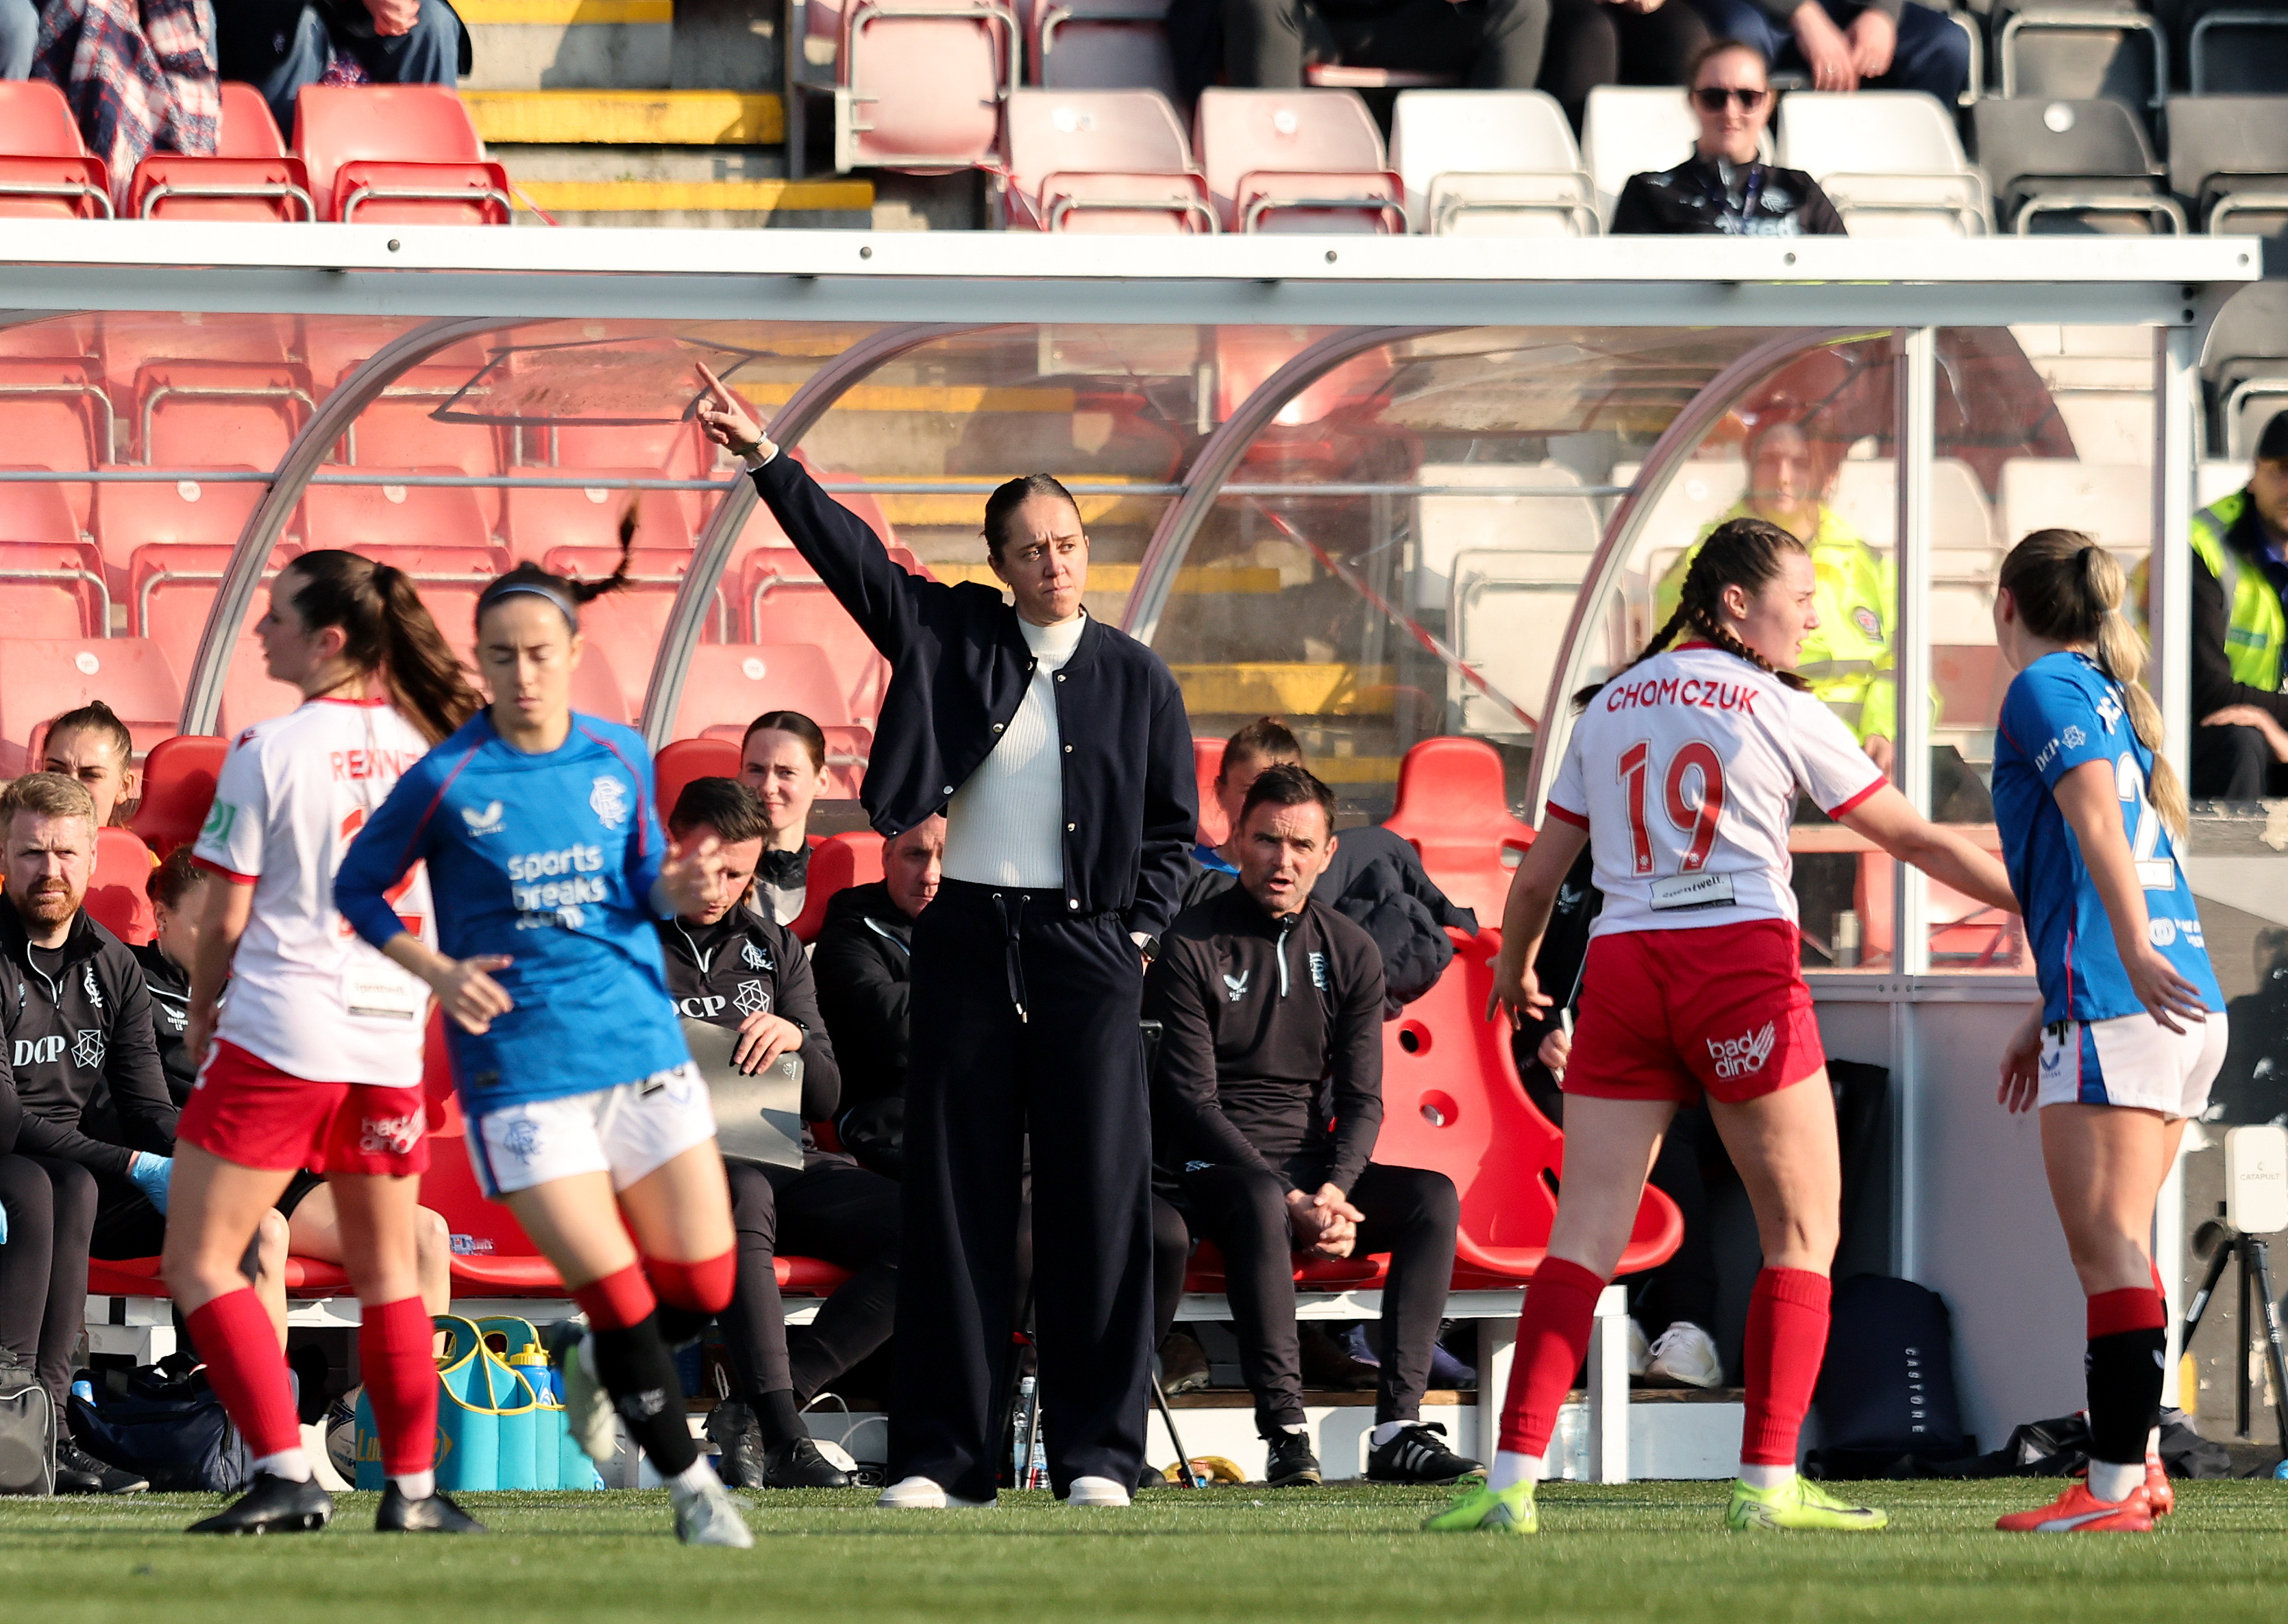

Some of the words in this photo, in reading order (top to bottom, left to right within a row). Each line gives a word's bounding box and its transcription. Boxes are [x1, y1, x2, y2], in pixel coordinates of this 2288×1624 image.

[1606, 678, 1759, 715] CHOMCZUK
[332, 749, 417, 781] RENN
[2034, 738, 2060, 772] DCP
[1616, 738, 1726, 878] 19
[507, 843, 604, 883] sports
[12, 1035, 65, 1066] DCP
[1706, 1029, 1754, 1059] bad
[1715, 1056, 1761, 1078] dino
[362, 1115, 408, 1137] bad
[2240, 1173, 2280, 1181] CATAPULT
[1905, 1347, 1924, 1433] CASTORE
